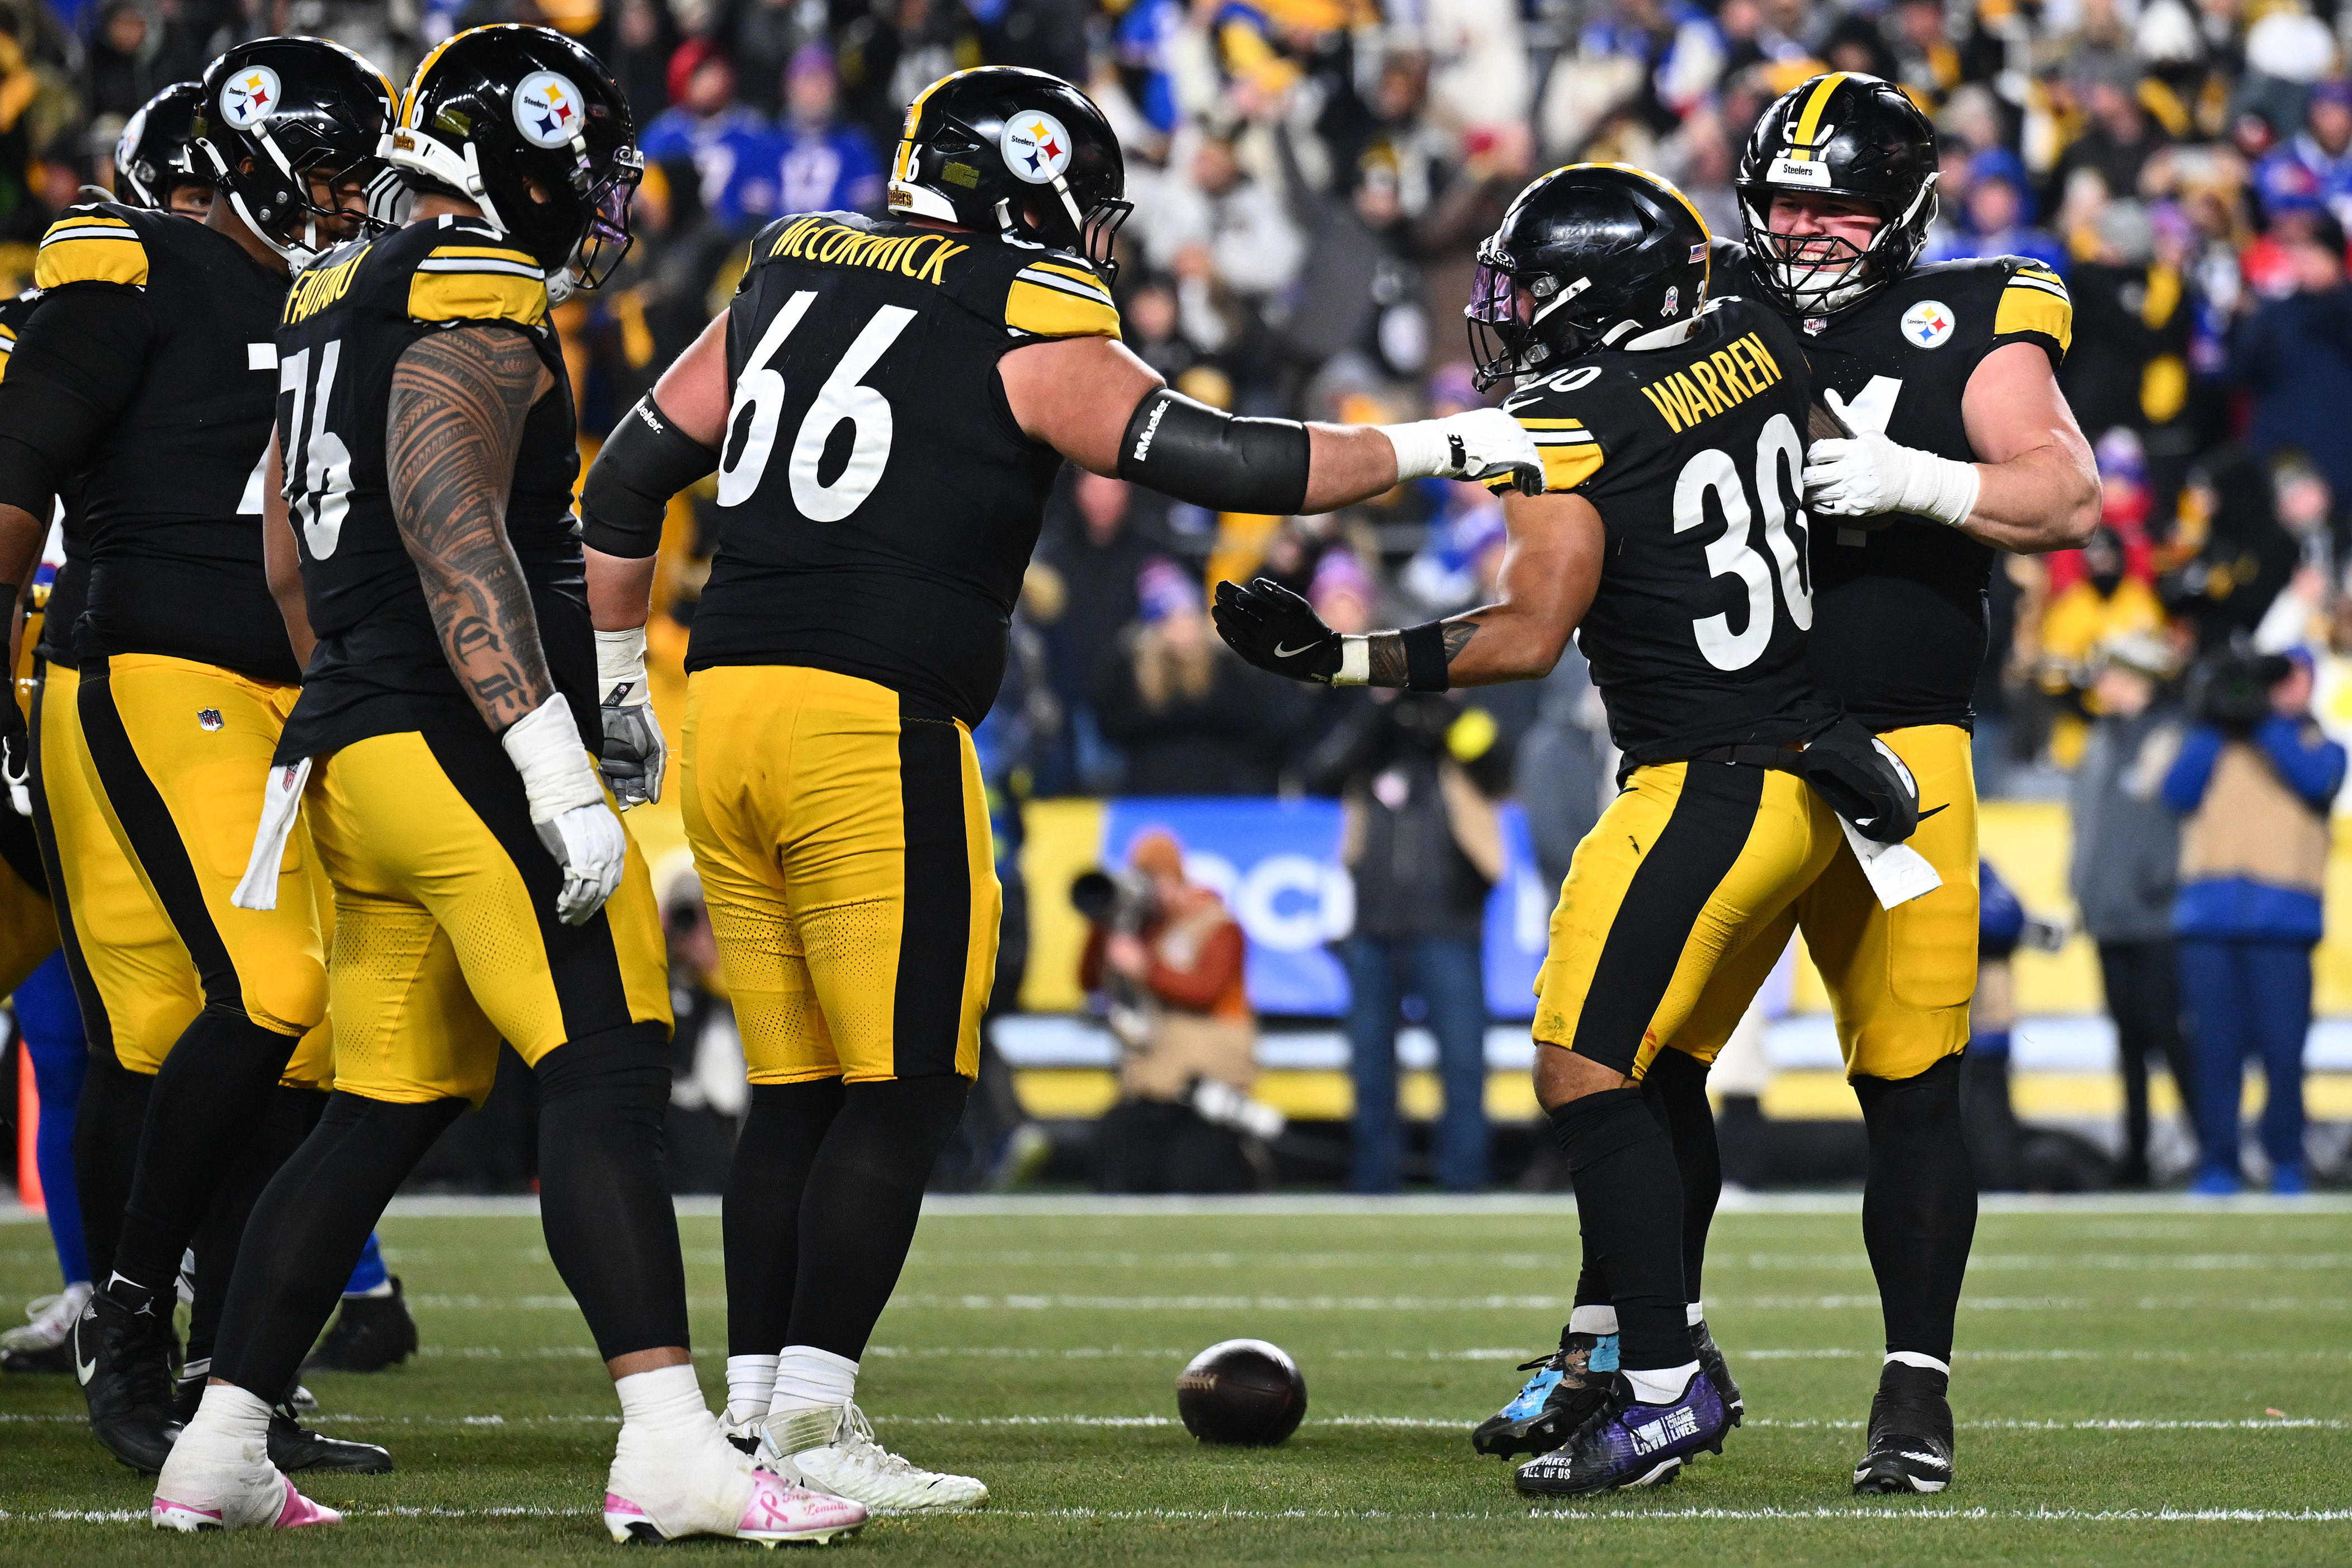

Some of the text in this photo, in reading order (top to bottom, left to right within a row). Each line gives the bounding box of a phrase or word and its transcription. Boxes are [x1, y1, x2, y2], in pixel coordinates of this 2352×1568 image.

[228, 87, 247, 97] Steelers
[523, 96, 548, 110] Steelers
[1011, 135, 1035, 148] Steelers
[1776, 121, 1835, 162] 54
[1783, 164, 1813, 176] Steelers
[1807, 320, 1823, 330] NFL
[1641, 332, 1782, 433] WARREN
[636, 394, 664, 434] ueller.
[717, 290, 918, 523] 66
[1136, 400, 1171, 453] Mueller.
[280, 339, 356, 560] 76
[1673, 413, 1813, 672] 30
[204, 716, 220, 726] NFL
[1670, 1421, 1700, 1441] LIVES.
[1522, 1467, 1571, 1480] ALL OF US
